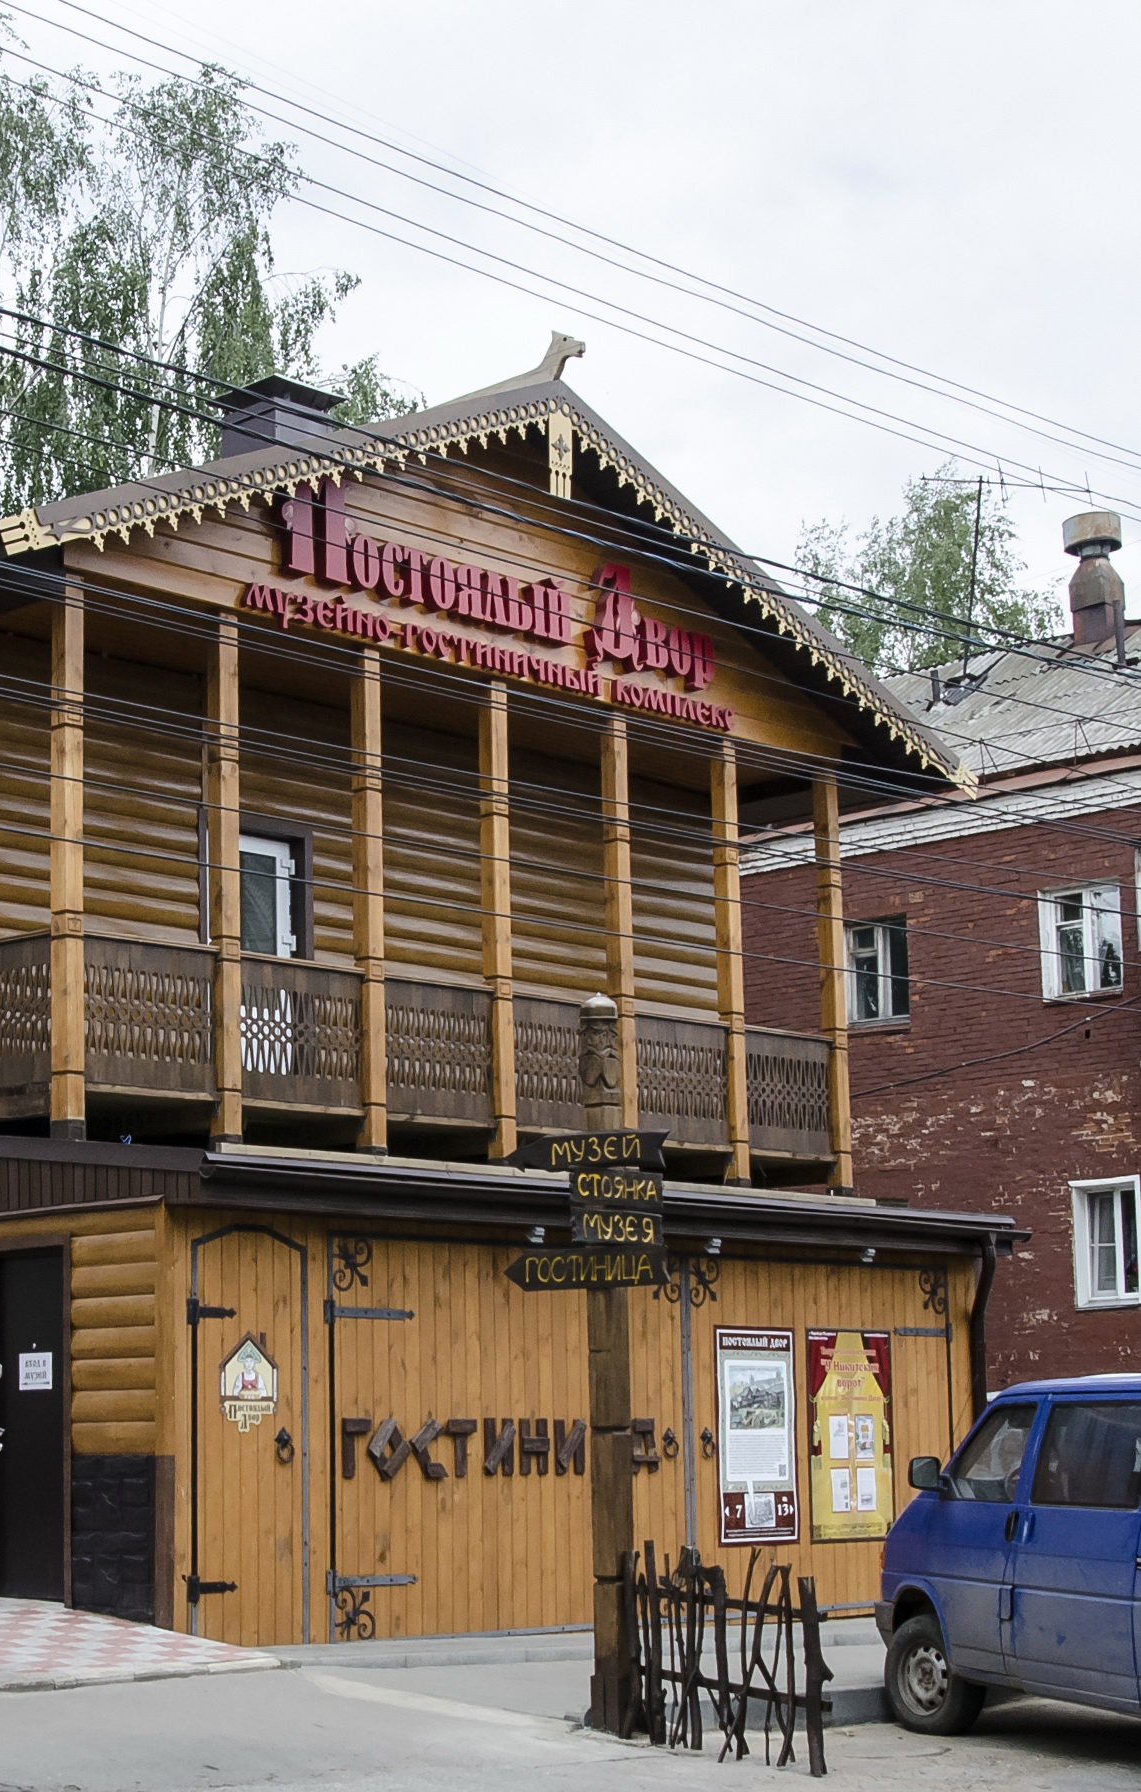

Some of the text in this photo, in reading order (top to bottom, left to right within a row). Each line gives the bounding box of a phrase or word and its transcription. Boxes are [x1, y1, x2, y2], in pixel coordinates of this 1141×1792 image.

[551, 1134, 641, 1166] МУЗЕЙ
[577, 1173, 658, 1201] СТОЯНКА
[582, 1213, 655, 1244] МУЗЕЯ
[525, 1254, 654, 1284] ГОСТИНИЦА
[341, 1415, 660, 1481] ГОСТИНИА
[735, 1504, 743, 1519] 7
[777, 1503, 789, 1517] 13
